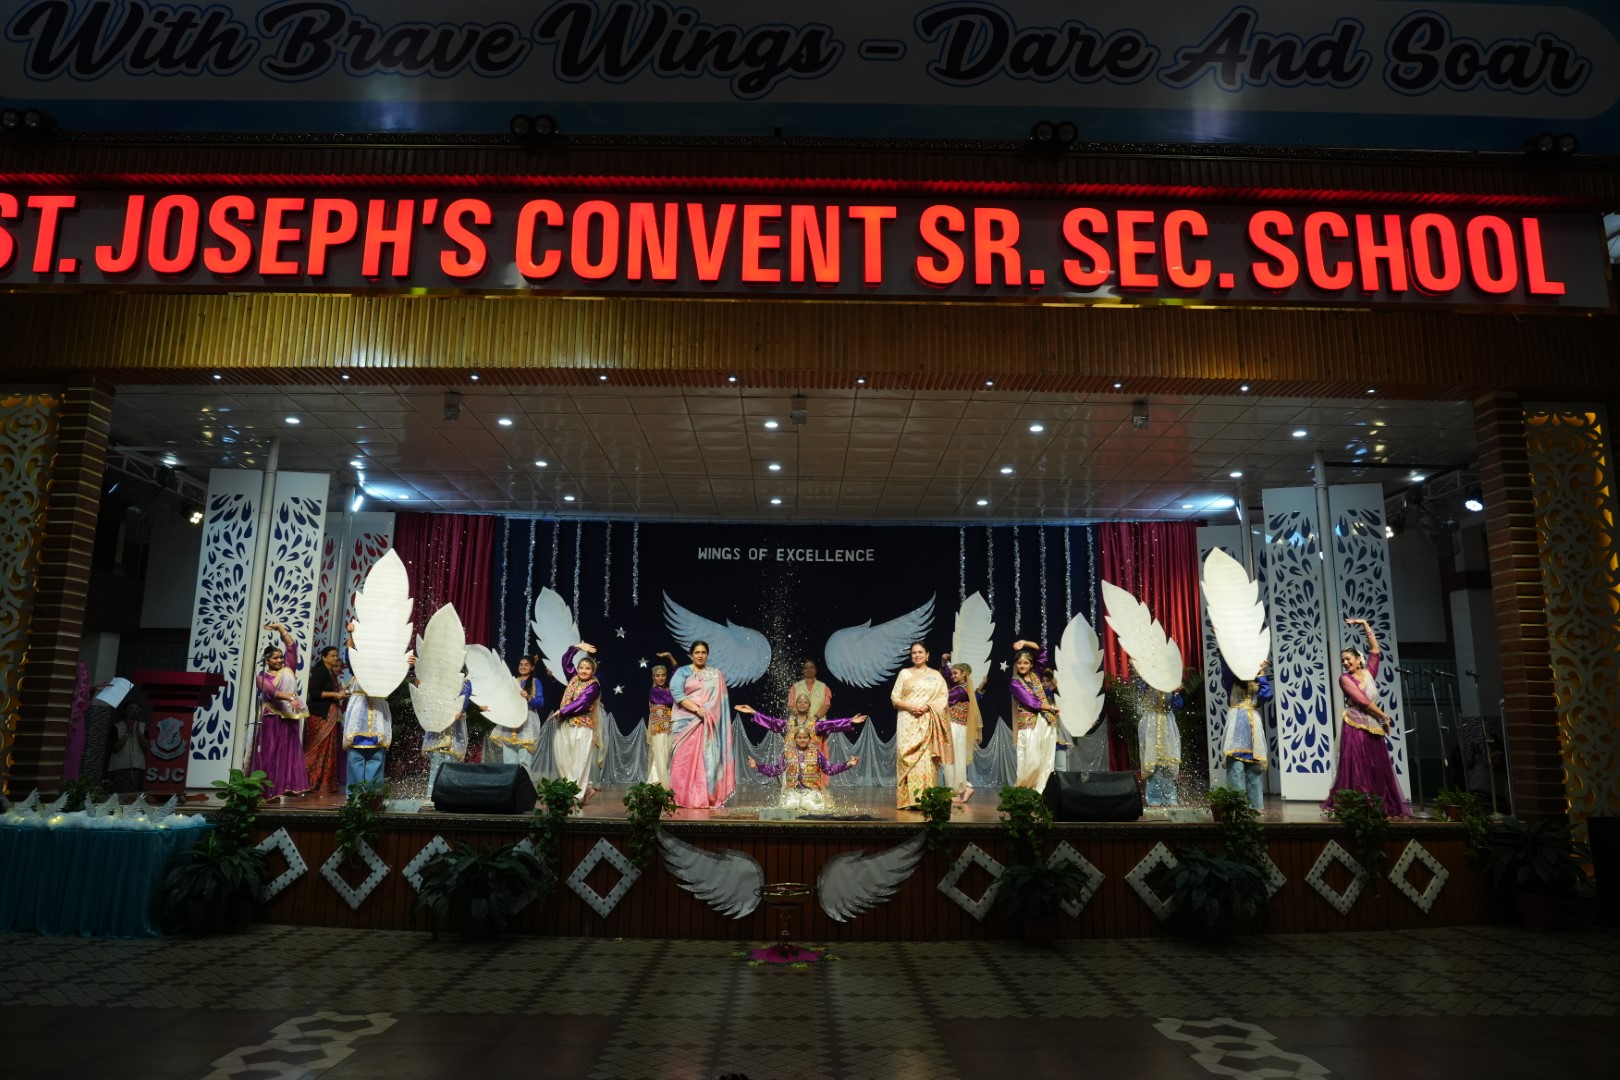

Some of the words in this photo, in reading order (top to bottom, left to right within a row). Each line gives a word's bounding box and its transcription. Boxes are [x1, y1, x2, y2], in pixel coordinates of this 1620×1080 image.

[12, 0, 254, 76] With
[262, 2, 526, 75] Brave
[538, 3, 838, 94] Wings
[921, 6, 1154, 81] Dare
[1164, 12, 1366, 86] And
[1389, 16, 1586, 90] Soar
[94, 194, 492, 278] JOSEPH'S
[515, 199, 897, 284] CONVENT
[916, 204, 1045, 286] SR.
[1062, 207, 1235, 289] SEC.
[1248, 210, 1566, 296] SCHOOL
[697, 547, 741, 560] WINGS
[748, 548, 769, 561] OF
[776, 548, 875, 563] EXCELLENCE
[145, 766, 185, 783] SJC
